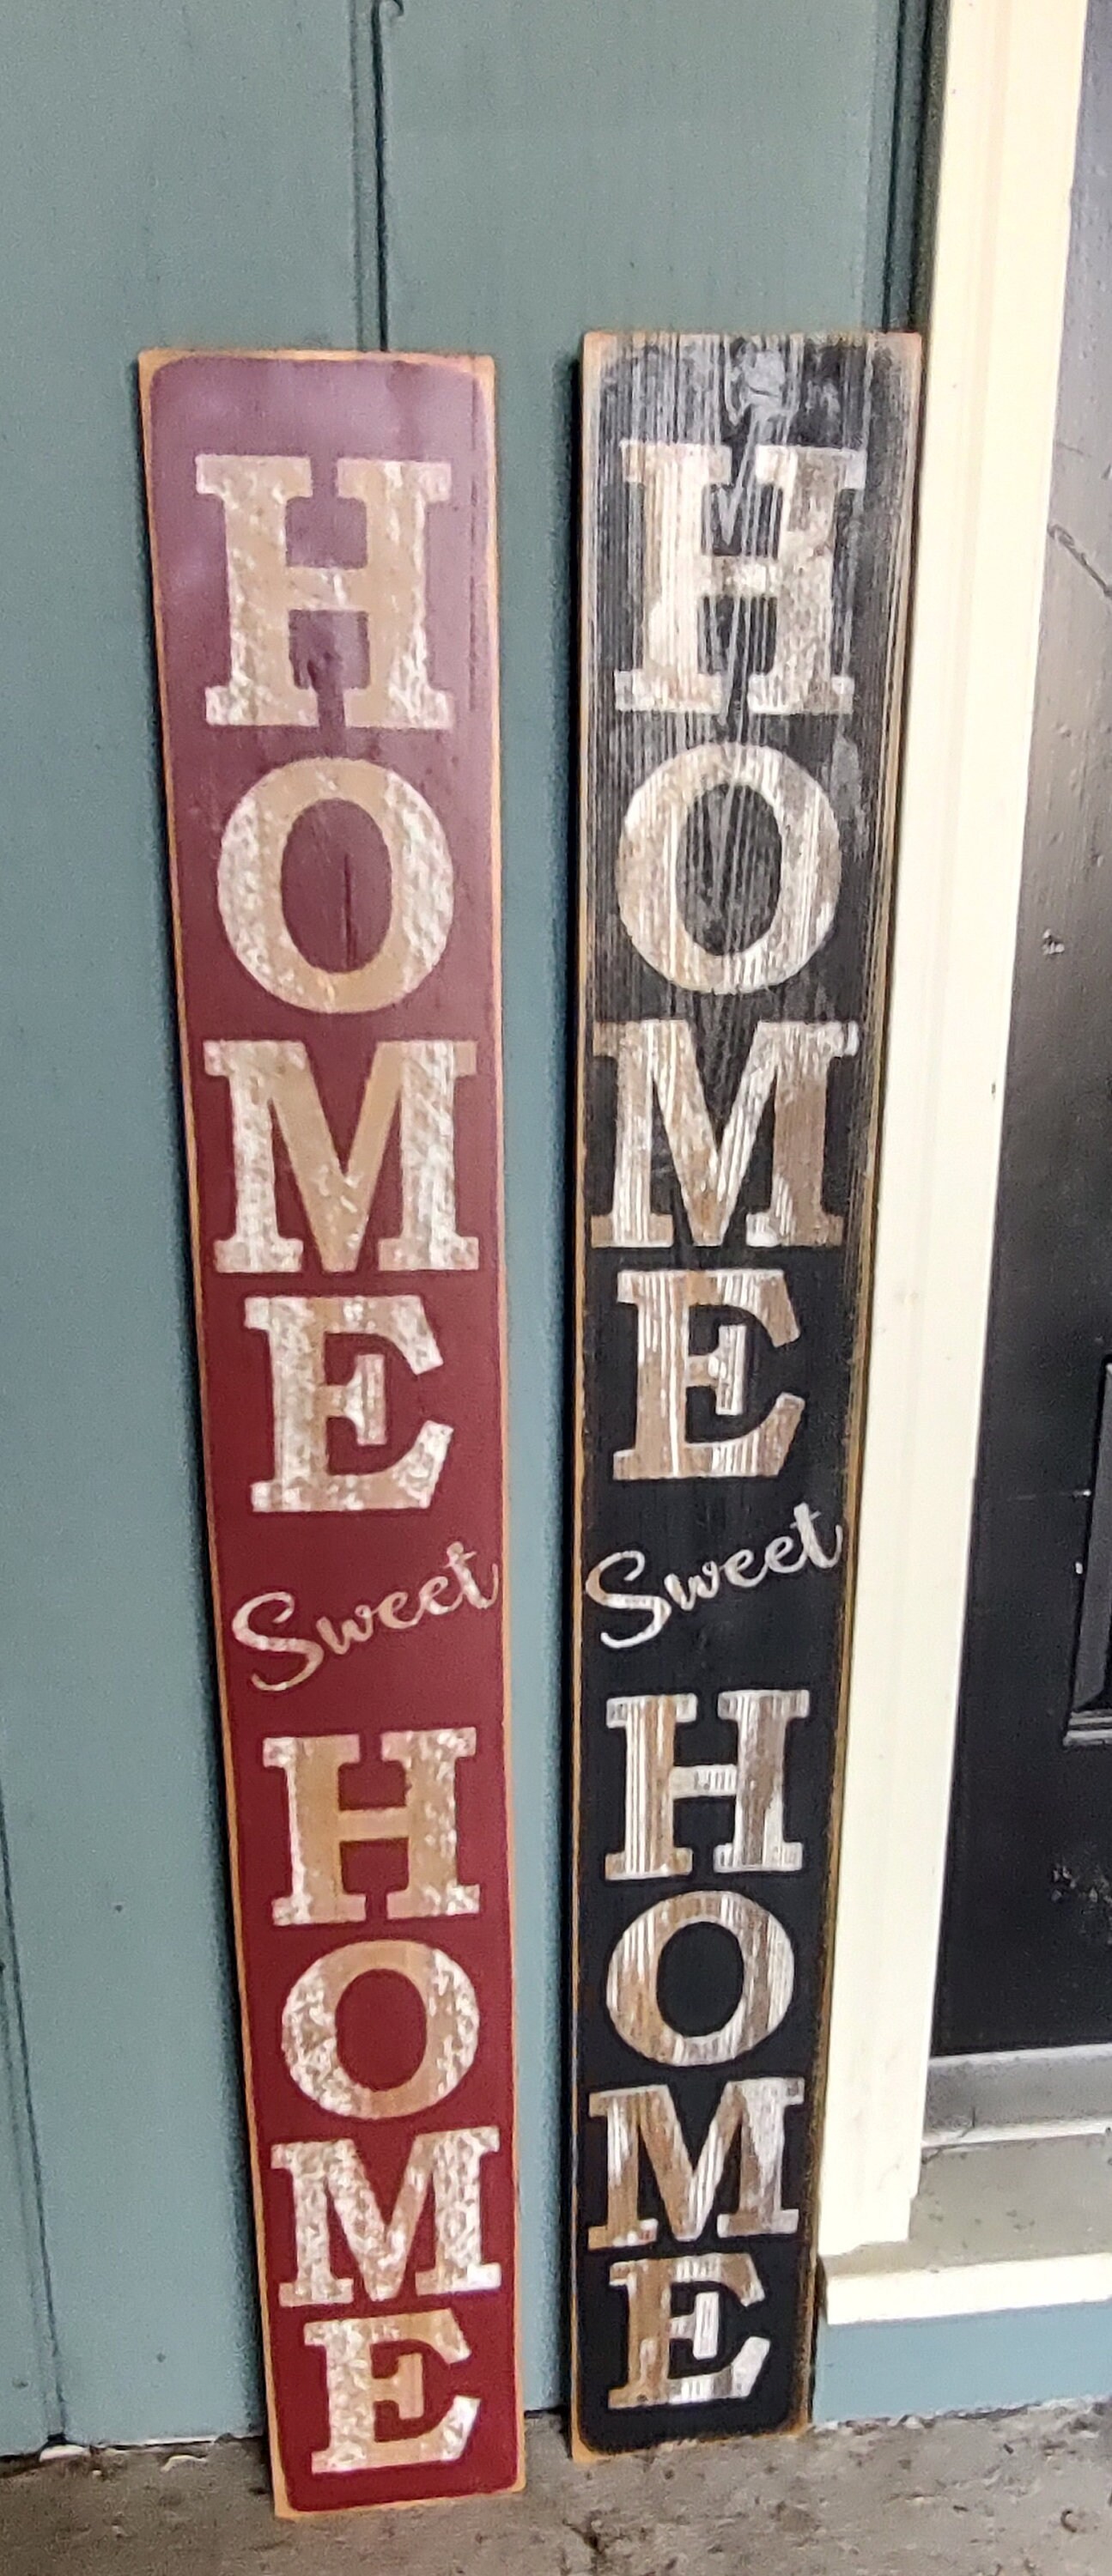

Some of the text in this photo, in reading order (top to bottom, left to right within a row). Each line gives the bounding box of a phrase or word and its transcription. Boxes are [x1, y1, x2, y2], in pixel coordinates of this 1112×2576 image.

[194, 453, 480, 1512] HOME
[590, 442, 865, 1480] HOME
[232, 1541, 499, 1693] Sweet
[585, 1503, 843, 1649] Sweet
[262, 1728, 501, 2475] HOME
[587, 1690, 811, 2409] HOME
